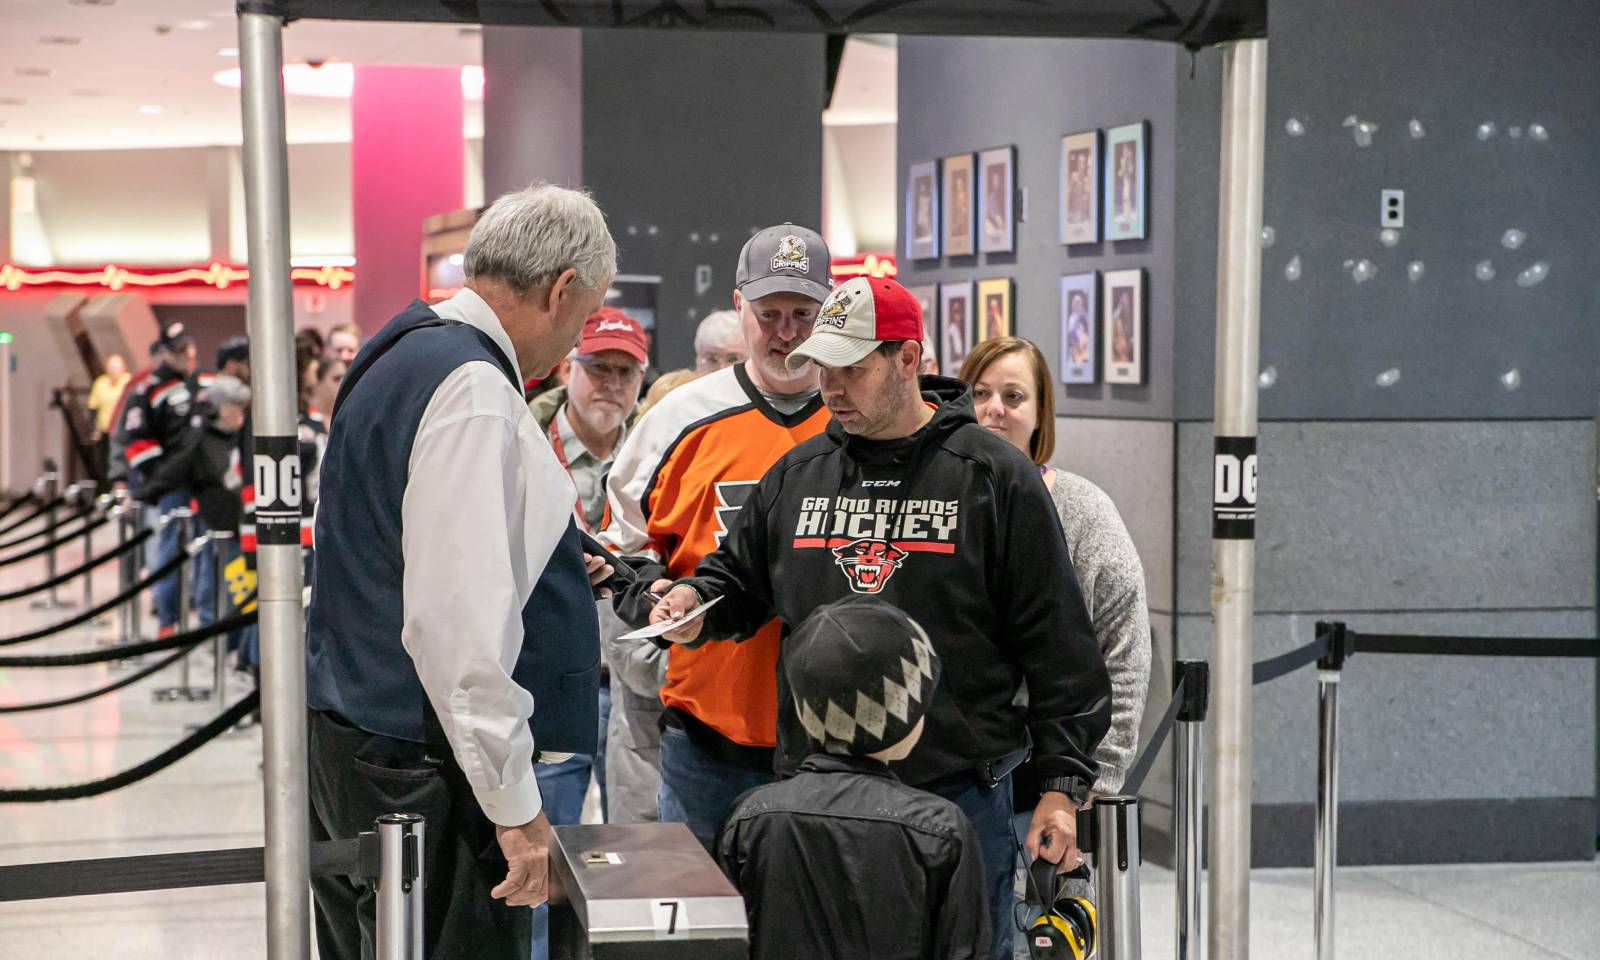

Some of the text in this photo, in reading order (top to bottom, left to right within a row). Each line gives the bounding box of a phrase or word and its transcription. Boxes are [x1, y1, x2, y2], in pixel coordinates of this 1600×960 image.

[772, 258, 808, 272] GRIFFINS
[253, 454, 301, 507] DG
[1214, 454, 1257, 503] DG
[660, 902, 678, 935] 7
